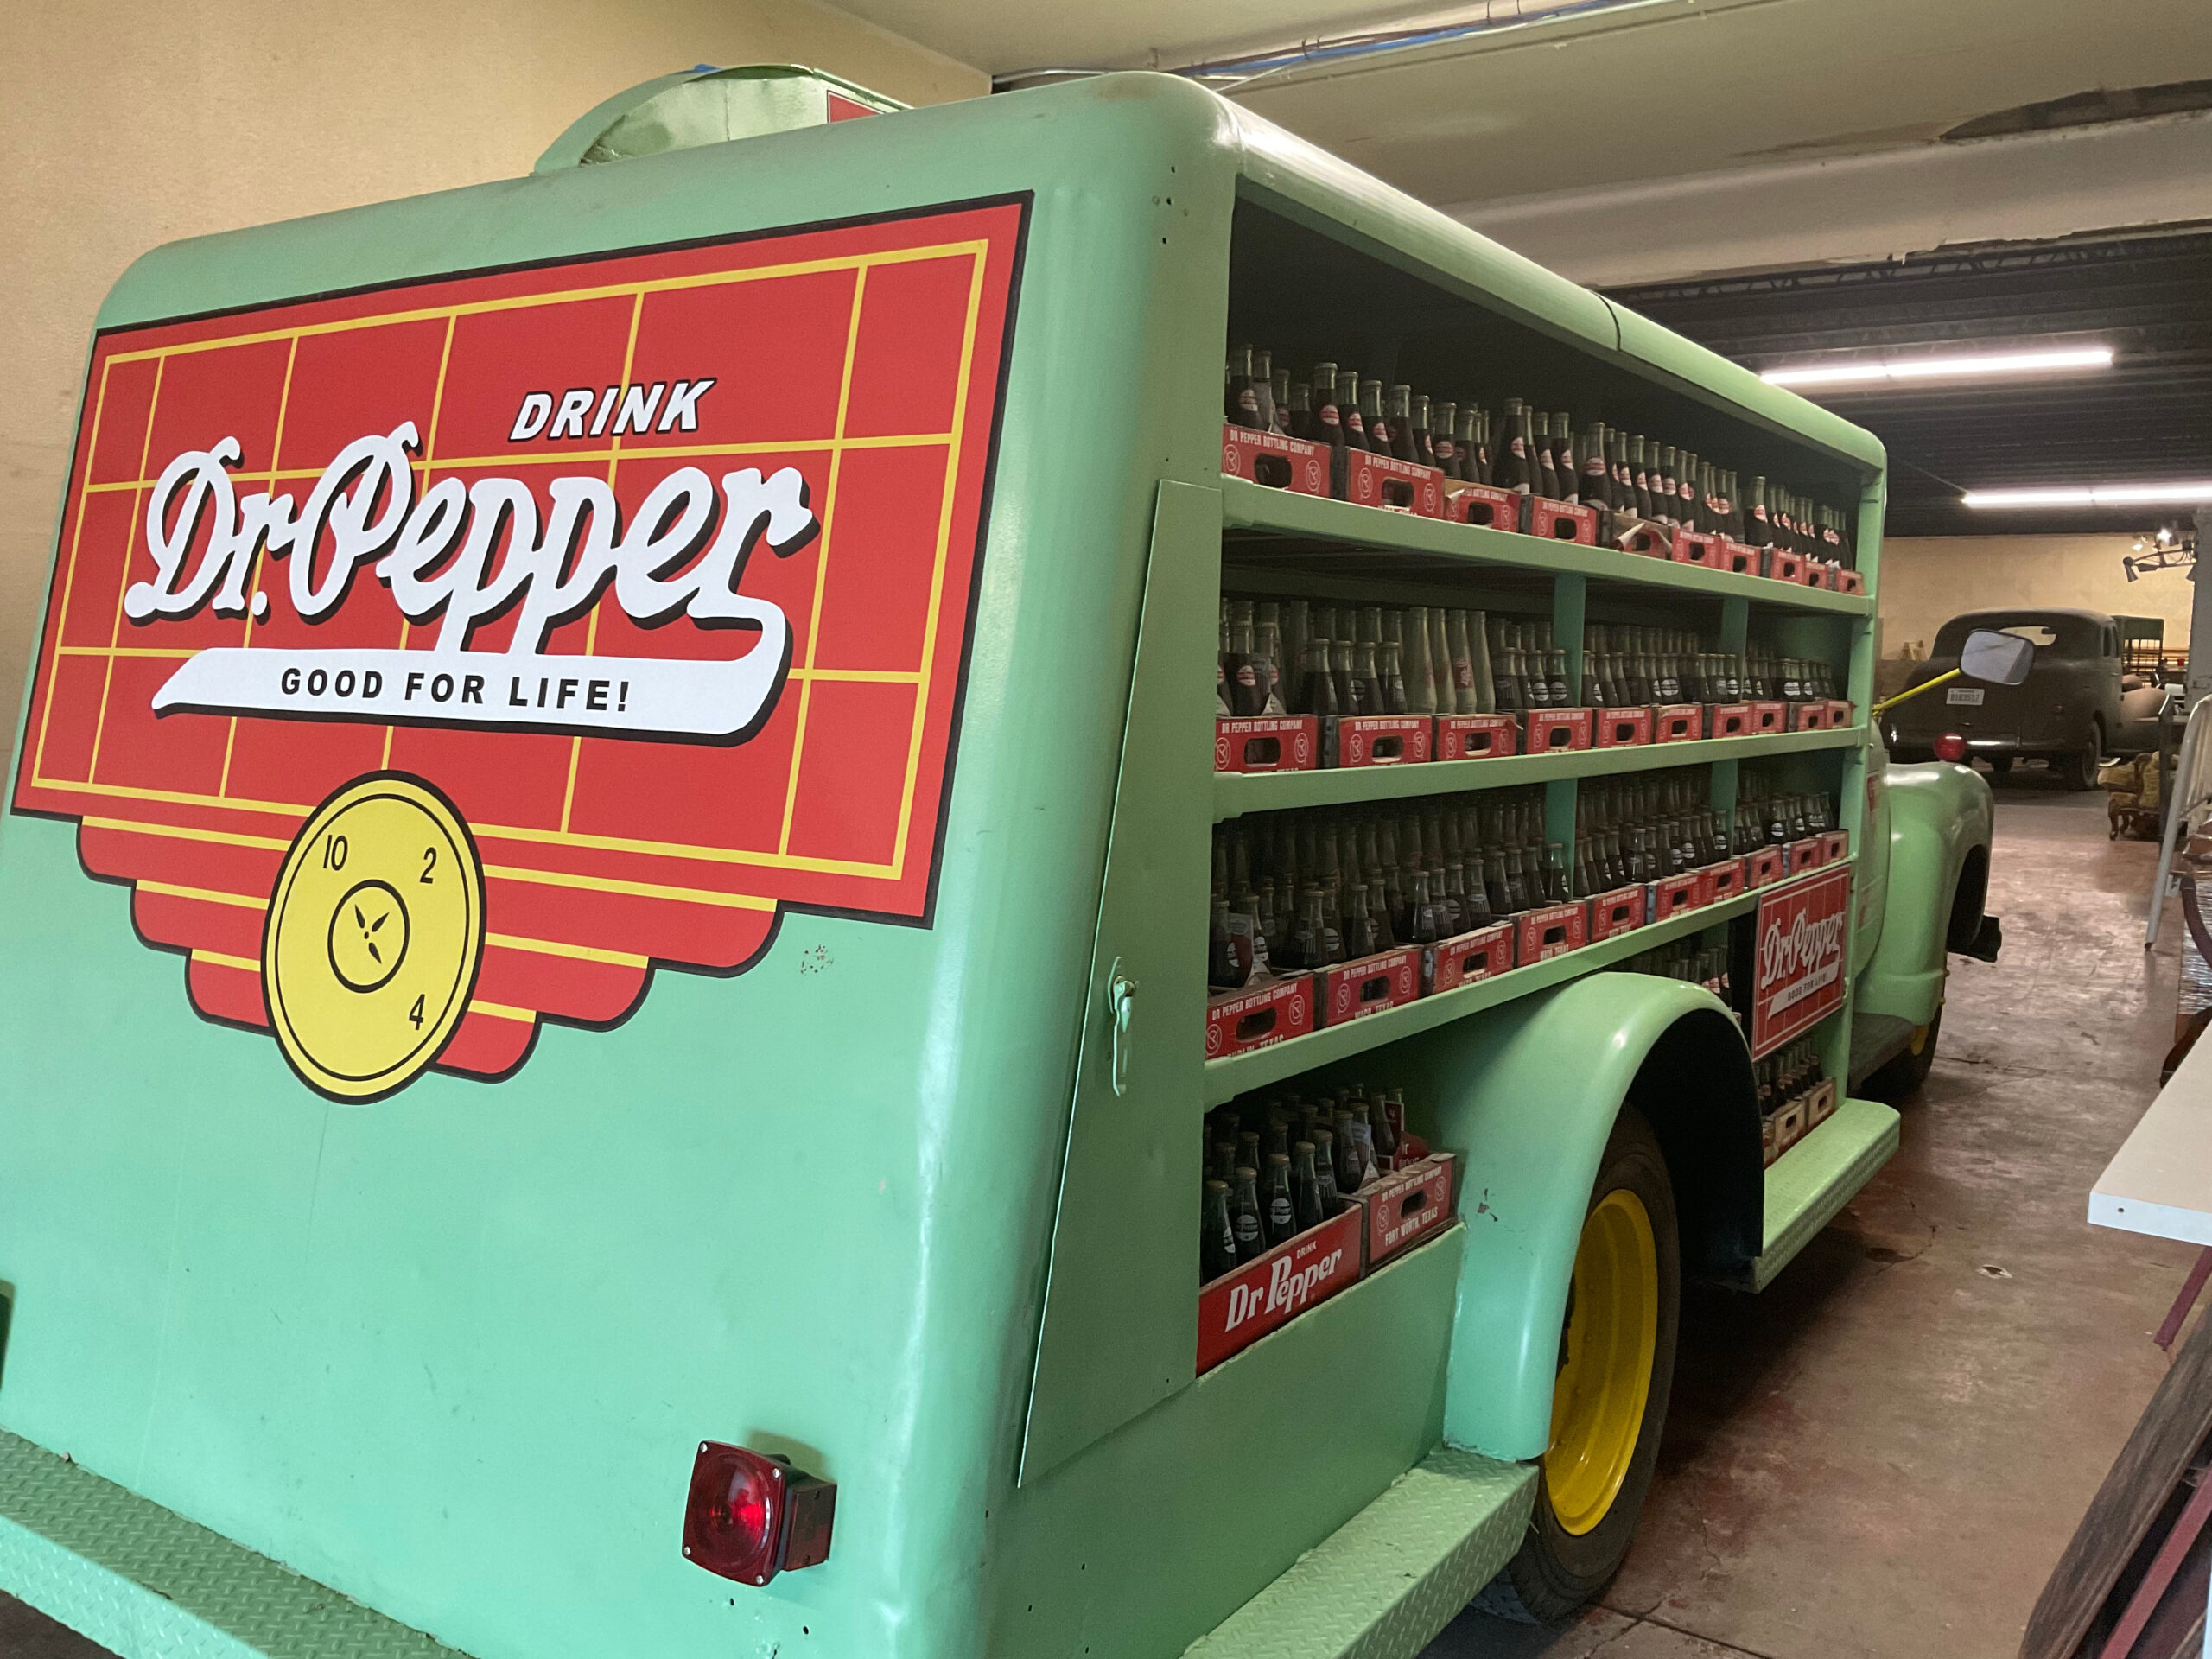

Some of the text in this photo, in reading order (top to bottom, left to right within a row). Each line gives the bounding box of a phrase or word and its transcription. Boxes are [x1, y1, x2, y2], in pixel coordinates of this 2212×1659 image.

[508, 378, 716, 442] DRINK
[1230, 429, 1315, 456] DR PEPPER BOTTLING COMPANY
[288, 420, 814, 655] Pepper
[281, 667, 632, 713] GOOD FOR LIFE!
[1221, 720, 1303, 734] DR PEPPER BOTTLING COMPANY
[322, 834, 348, 872] 10
[419, 847, 437, 885] 2
[409, 993, 426, 1031] 4
[1212, 982, 1298, 1020] DR PEPPER BOTTLING COMPANY
[1422, 1206, 1438, 1224] TEXAS
[1296, 1240, 1317, 1260] DRINK
[1224, 1249, 1342, 1333] Dr Pepper
